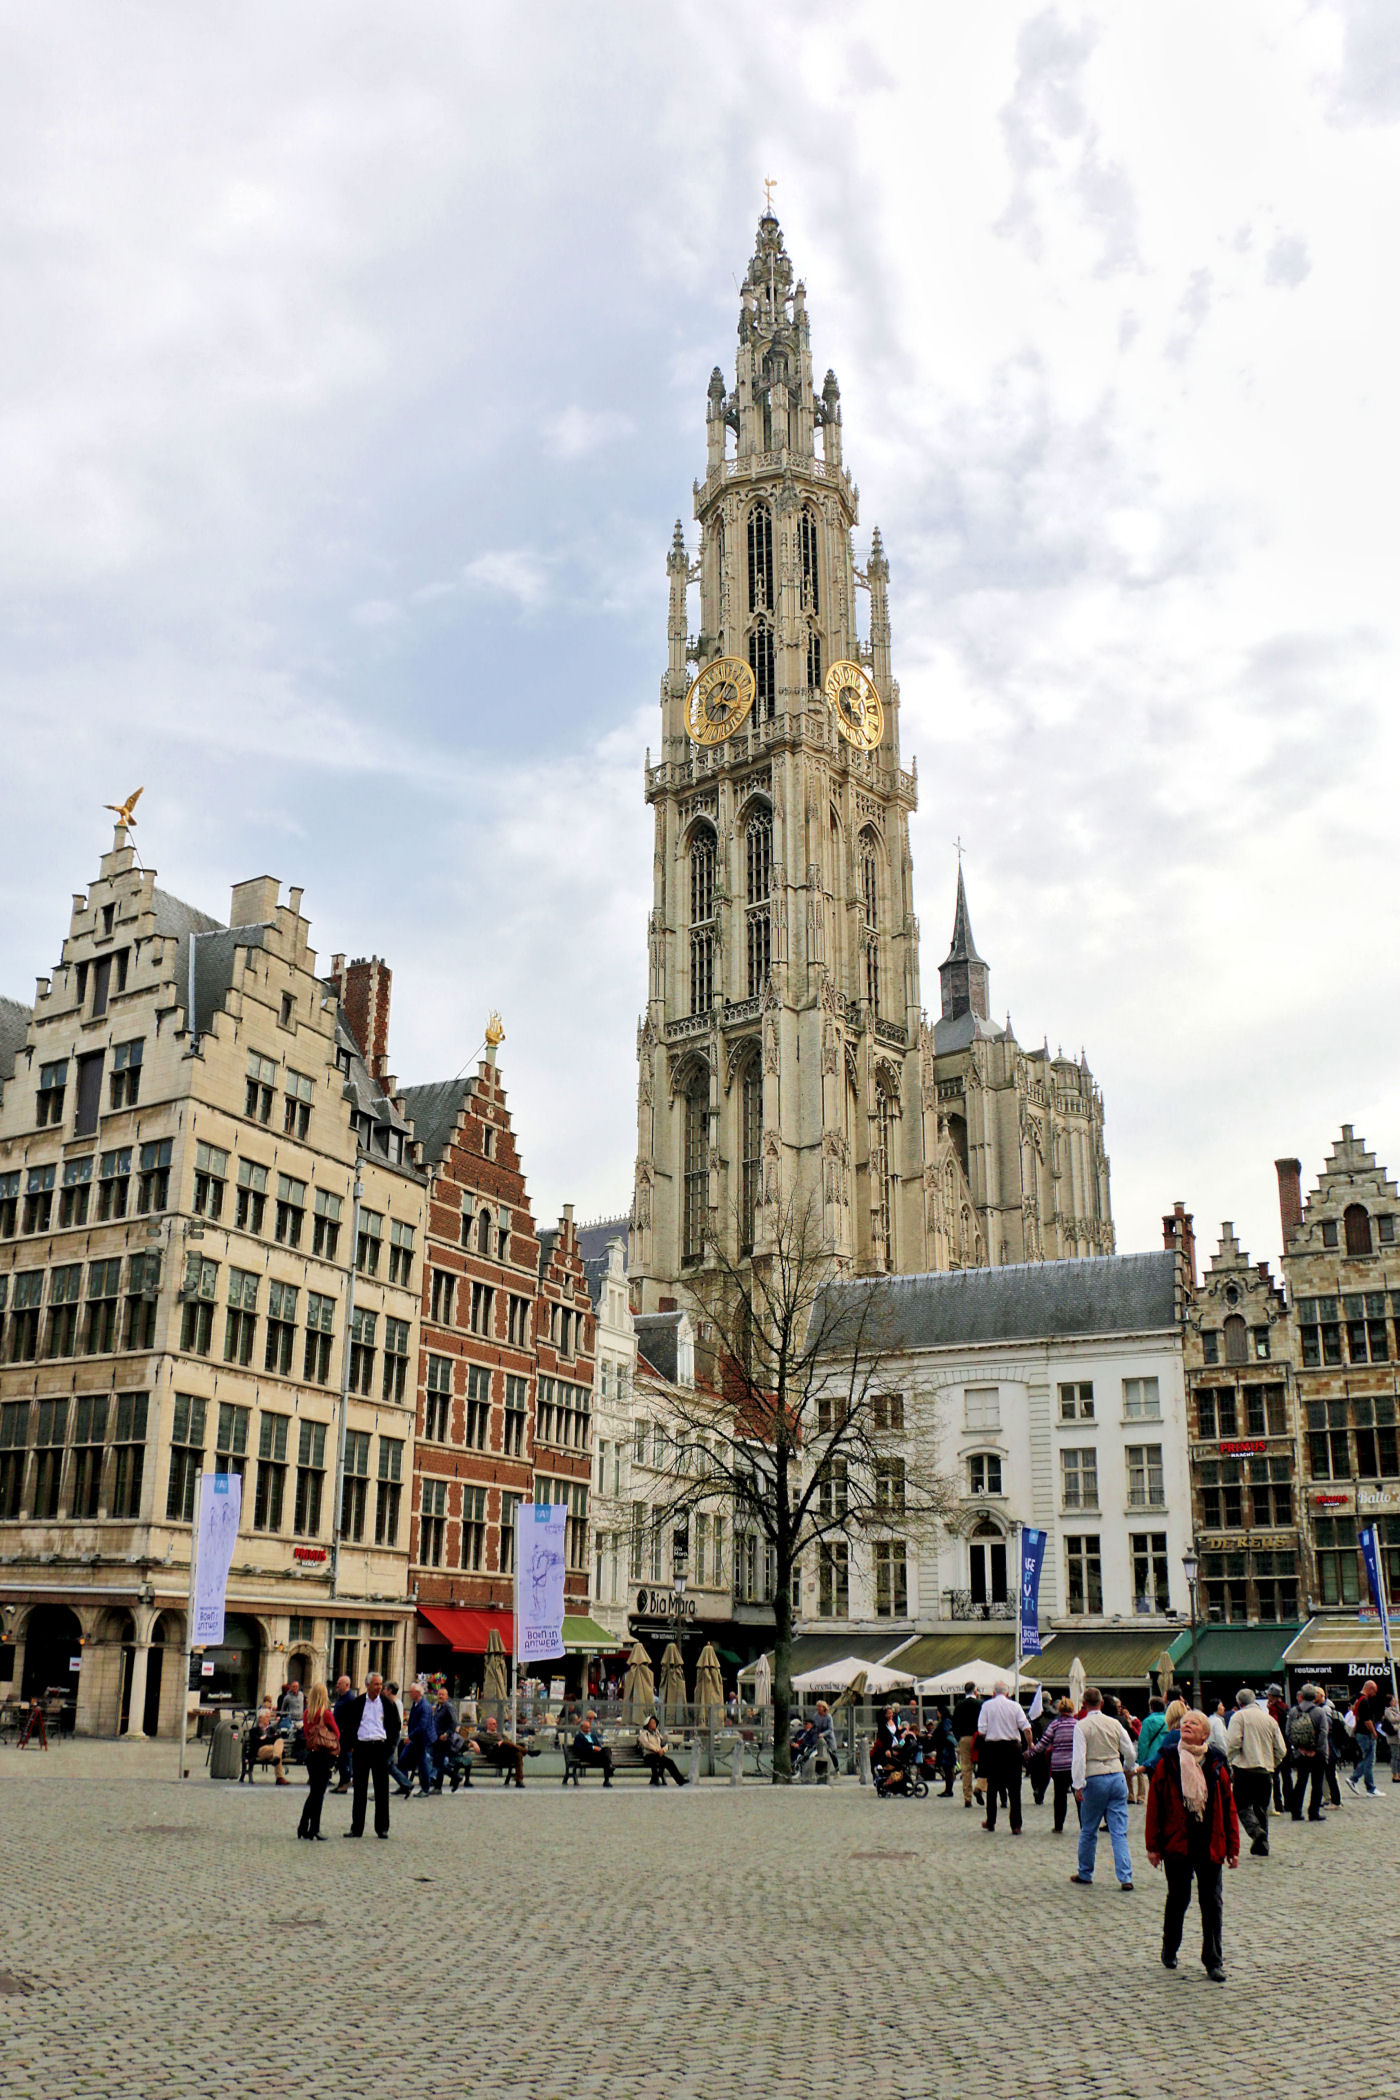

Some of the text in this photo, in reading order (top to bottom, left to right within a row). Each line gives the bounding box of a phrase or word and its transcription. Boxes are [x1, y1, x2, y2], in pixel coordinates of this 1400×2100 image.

[1220, 1441, 1266, 1453] PRIMUS
[1316, 1495, 1348, 1505] PRIMUS
[1210, 1535, 1286, 1550] DE REUS
[294, 1547, 327, 1562] PRIMUS
[650, 1591, 696, 1617] Bia Mara
[1294, 1663, 1391, 1677] restaurant Balto's
